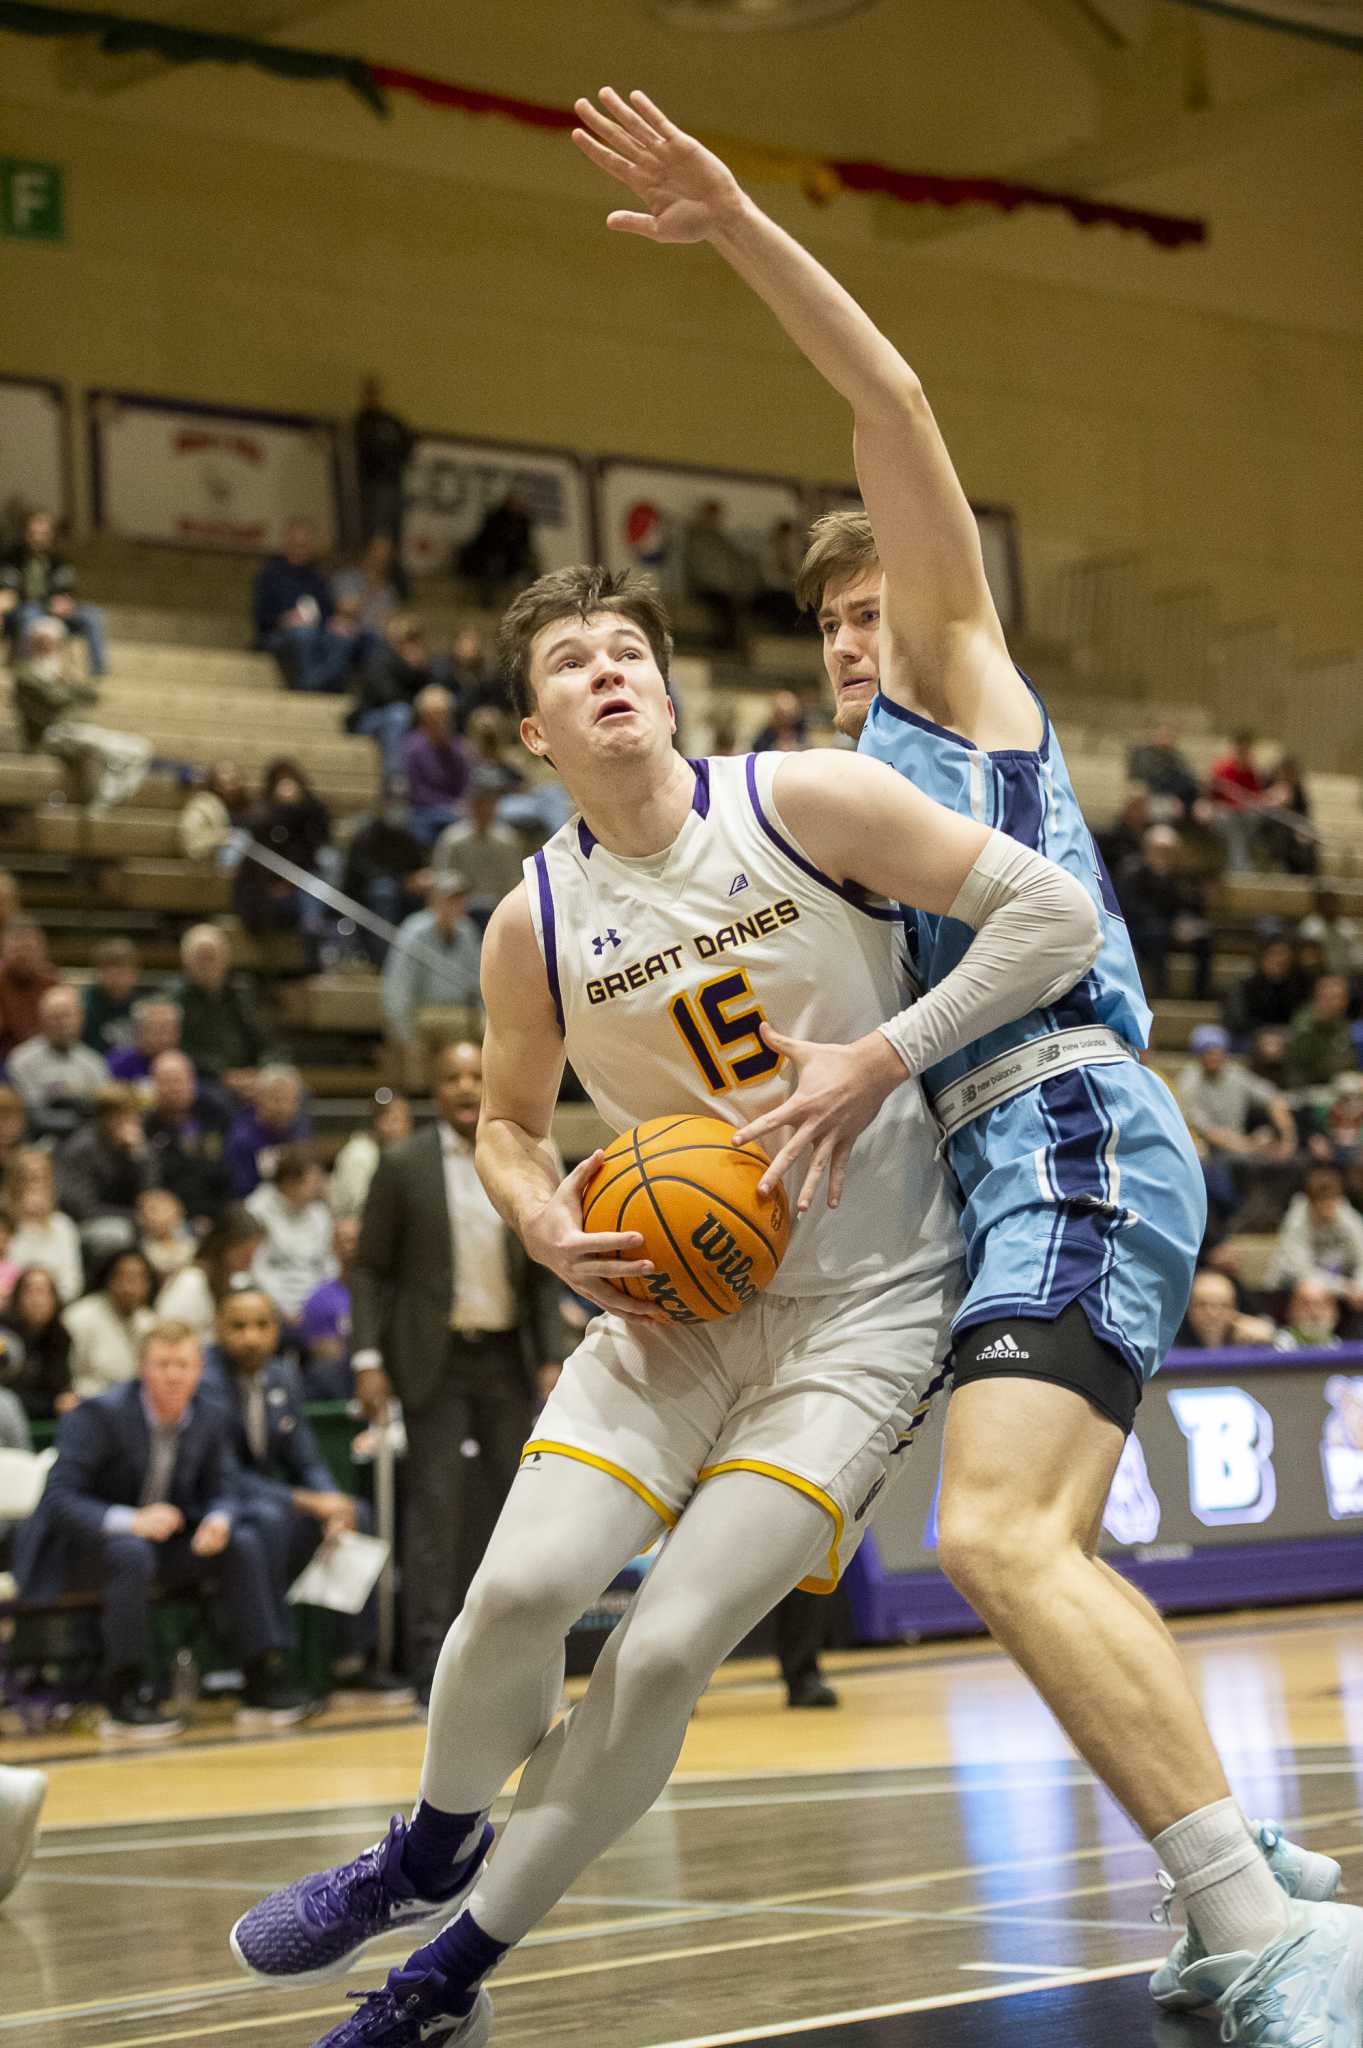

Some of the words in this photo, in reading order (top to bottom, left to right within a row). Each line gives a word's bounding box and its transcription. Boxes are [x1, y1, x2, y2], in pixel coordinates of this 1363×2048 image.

[13, 171, 48, 228] F
[586, 945, 683, 1004] GREAT
[692, 898, 800, 959] DANES
[667, 965, 785, 1096] 15
[977, 1080, 991, 1093] new
[976, 1348, 1030, 1361] adidas
[1168, 1386, 1277, 1527] B
